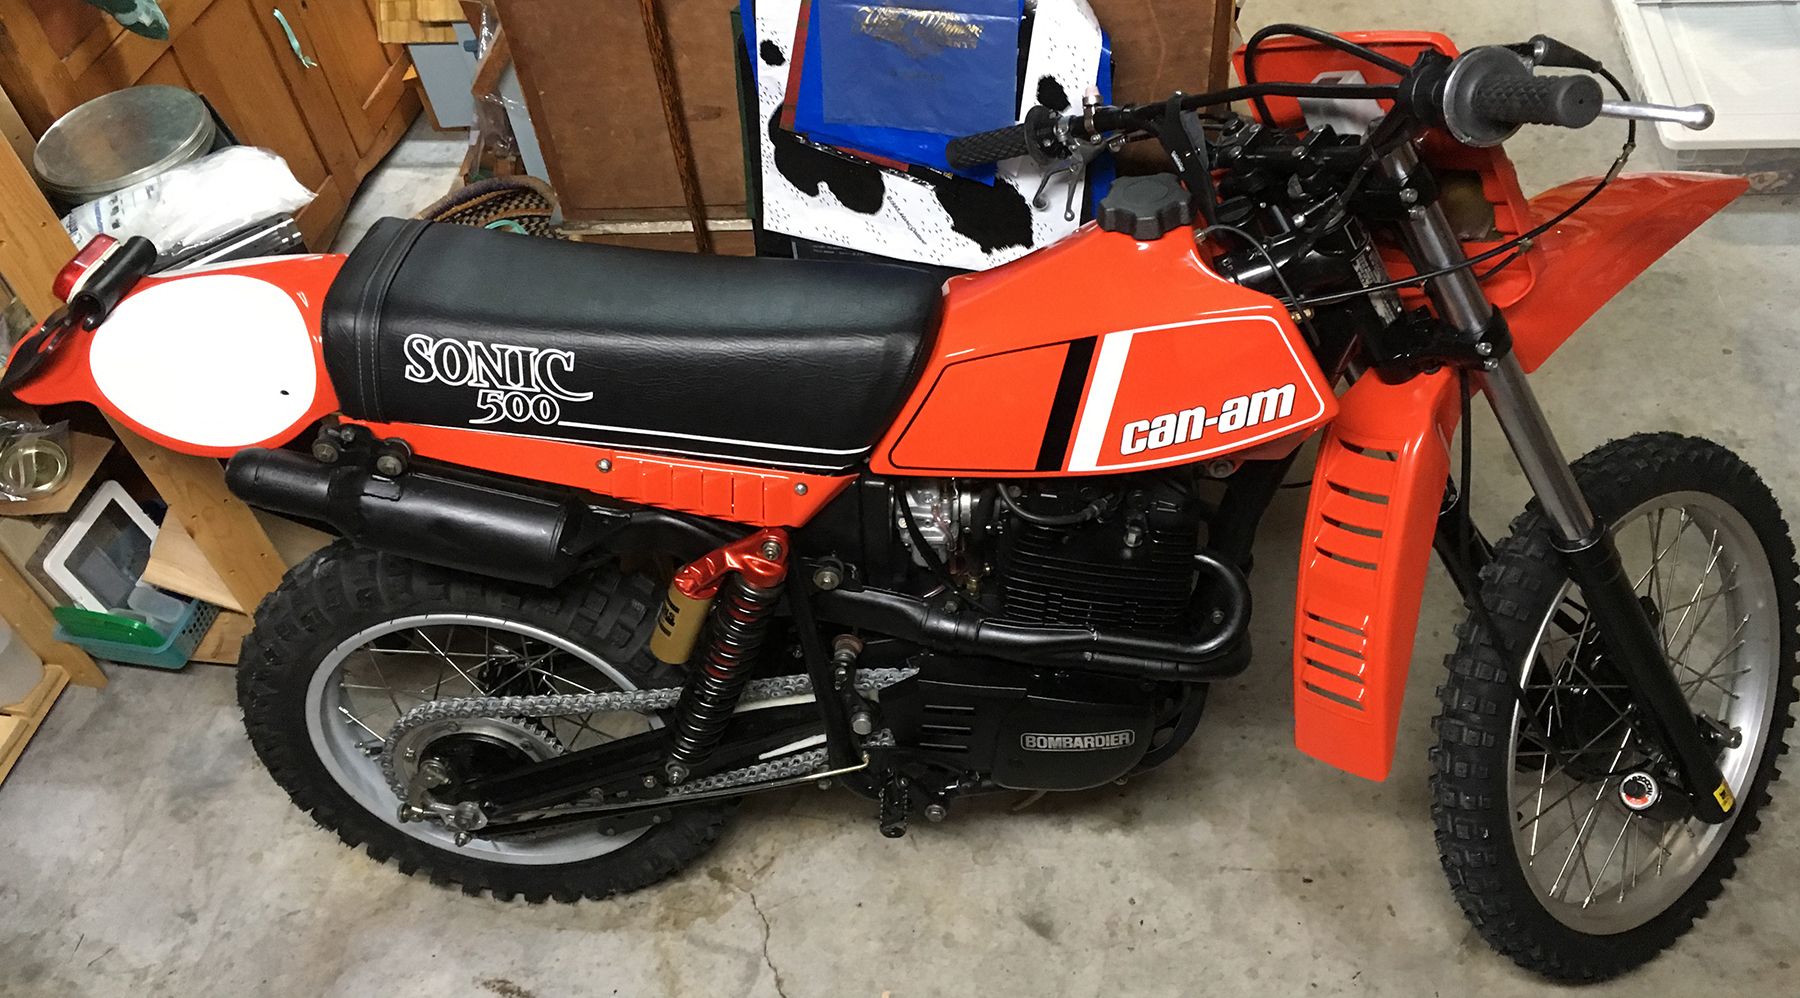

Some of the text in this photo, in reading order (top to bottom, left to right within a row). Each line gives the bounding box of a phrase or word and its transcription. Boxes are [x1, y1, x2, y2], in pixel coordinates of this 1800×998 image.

[403, 333, 594, 402] SONIC
[468, 389, 560, 425] 500
[1120, 383, 1297, 456] can-am
[1025, 732, 1130, 748] BOMBARDIER
